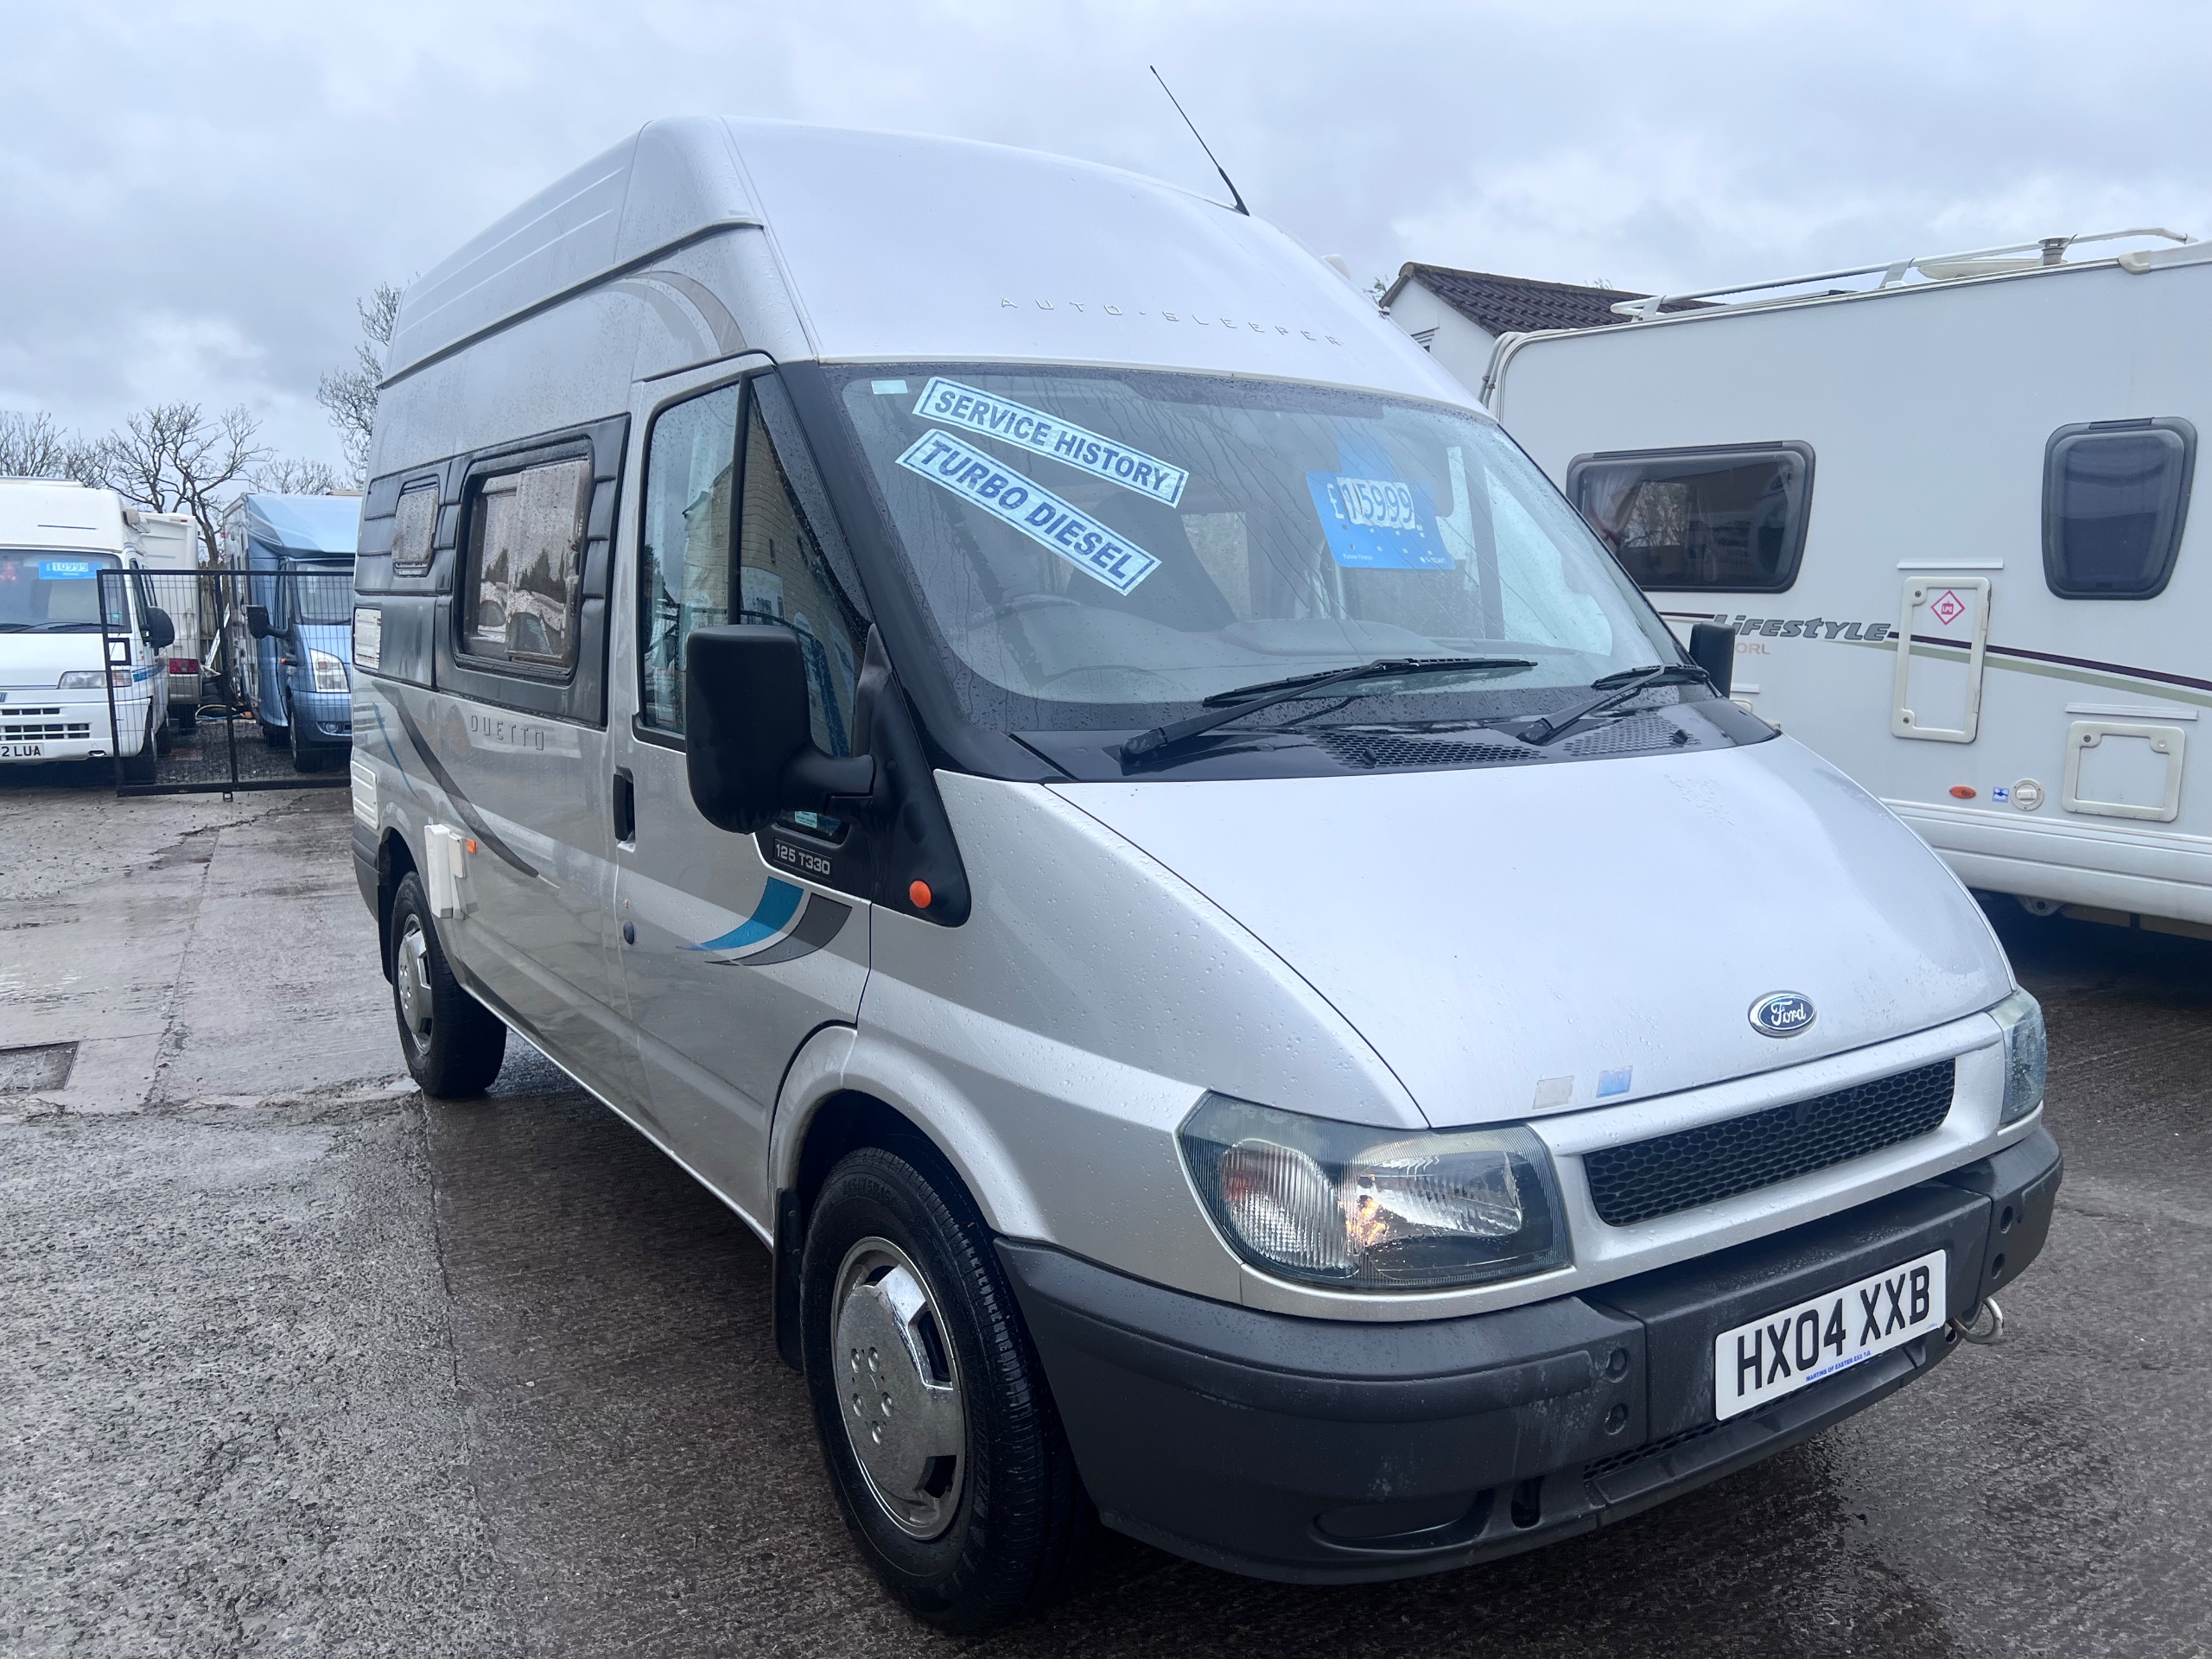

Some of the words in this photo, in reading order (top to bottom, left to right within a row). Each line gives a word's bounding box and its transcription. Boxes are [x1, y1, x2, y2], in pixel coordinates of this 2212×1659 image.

[935, 391, 1052, 447] SERVICE
[1054, 429, 1170, 493] HISTORY
[921, 439, 1029, 512] TURBO
[1024, 503, 1135, 581] DIESEL
[471, 715, 544, 751] DUETTO
[14, 745, 41, 757] LUA
[776, 843, 796, 863] 125
[798, 851, 830, 875] T330
[1770, 1000, 1807, 1026] Ford
[1737, 1298, 1847, 1397] HX04
[1859, 1265, 1930, 1347] XXB
[1806, 1369, 1827, 1382] MARTINS
[1834, 1357, 1853, 1370] EXETER
